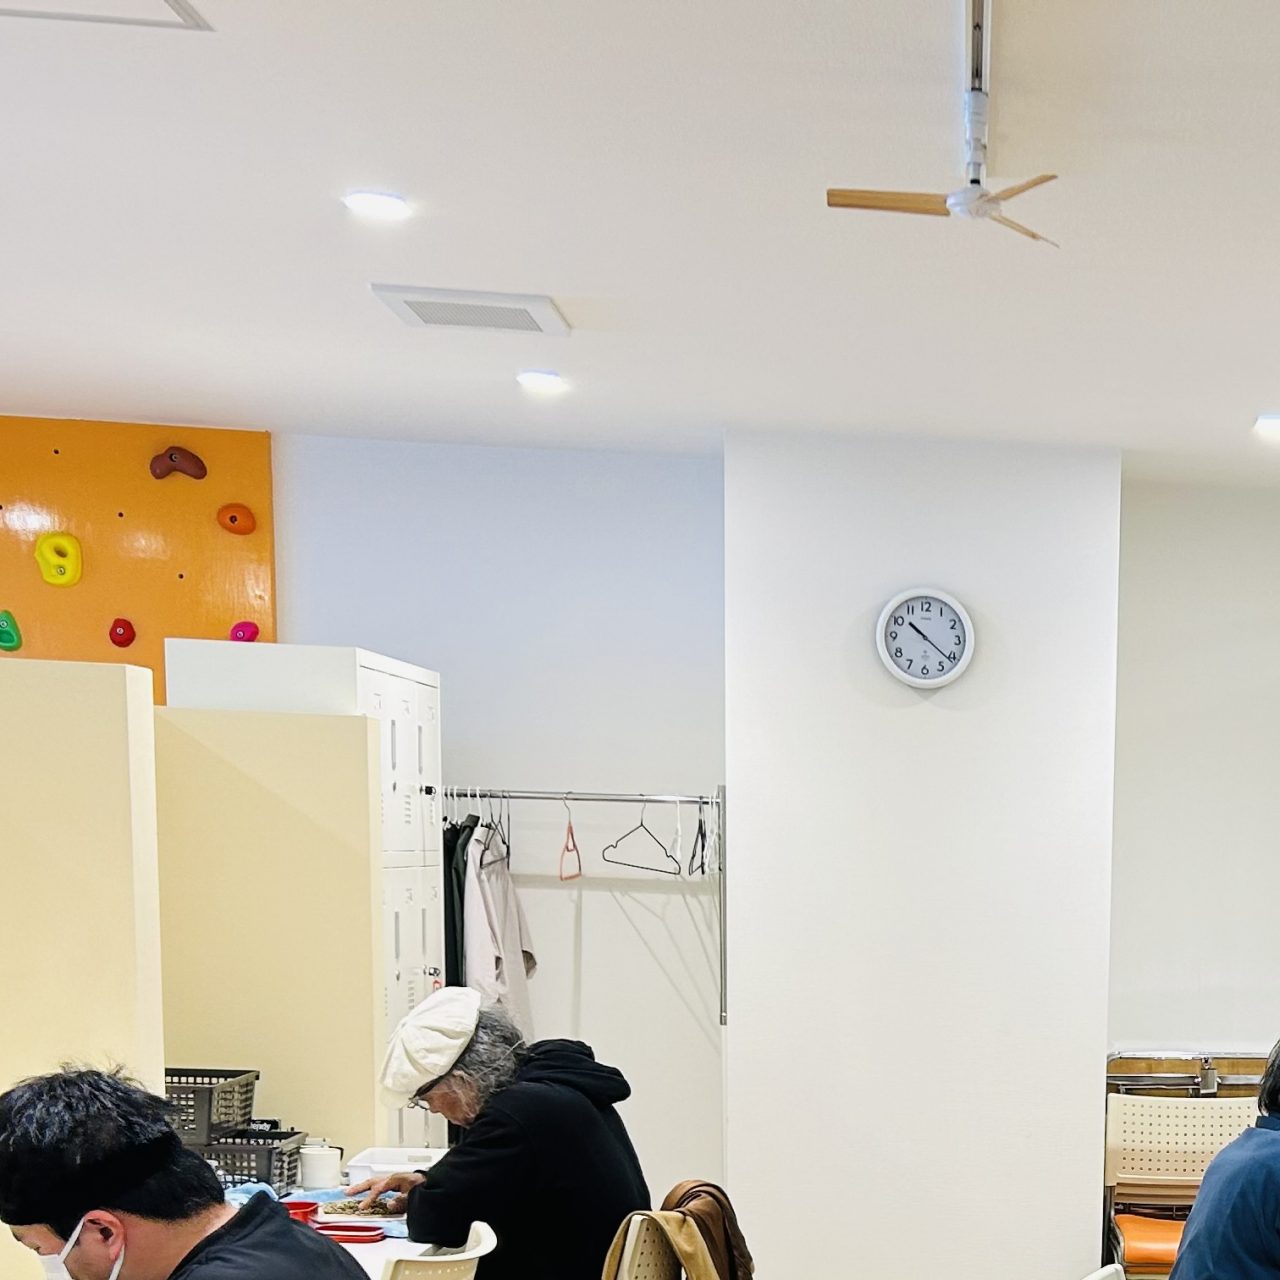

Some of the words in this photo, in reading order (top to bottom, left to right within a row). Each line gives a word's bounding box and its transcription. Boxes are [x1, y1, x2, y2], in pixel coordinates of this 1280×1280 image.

[907, 604, 914, 616] 11
[920, 602, 932, 612] 12
[894, 616, 904, 626] 10
[950, 619, 956, 630] 2
[890, 630, 898, 641] 9
[954, 635, 962, 646] 3
[894, 647, 903, 658] 8
[948, 650, 956, 662] 4
[906, 659, 913, 670] 7
[921, 664, 929, 675] 6
[937, 661, 945, 672] 5
